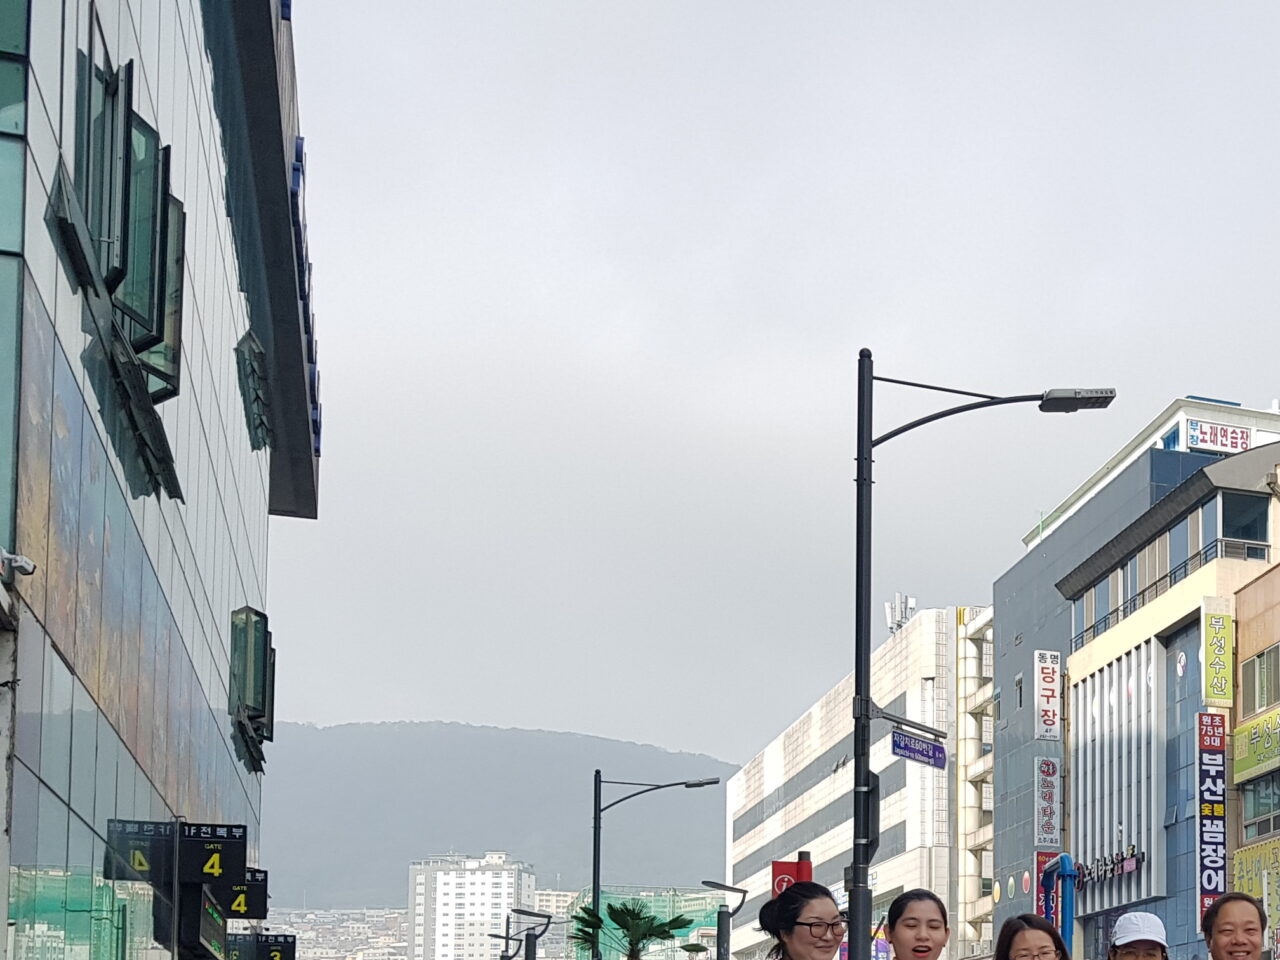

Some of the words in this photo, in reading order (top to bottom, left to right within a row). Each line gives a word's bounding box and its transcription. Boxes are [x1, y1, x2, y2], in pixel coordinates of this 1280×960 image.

[1199, 423, 1250, 451] 노래연습장
[1038, 652, 1059, 665] 동명
[1208, 615, 1228, 696] 부성수산
[1040, 666, 1058, 727] 당구장
[1201, 714, 1223, 727] 원조
[1201, 726, 1224, 737] 75년
[1203, 736, 1222, 747] 3대
[1200, 803, 1225, 817] 숯불
[183, 826, 197, 837] 1F
[204, 842, 223, 850] GATE
[202, 852, 223, 878] 4
[231, 893, 248, 914] 4
